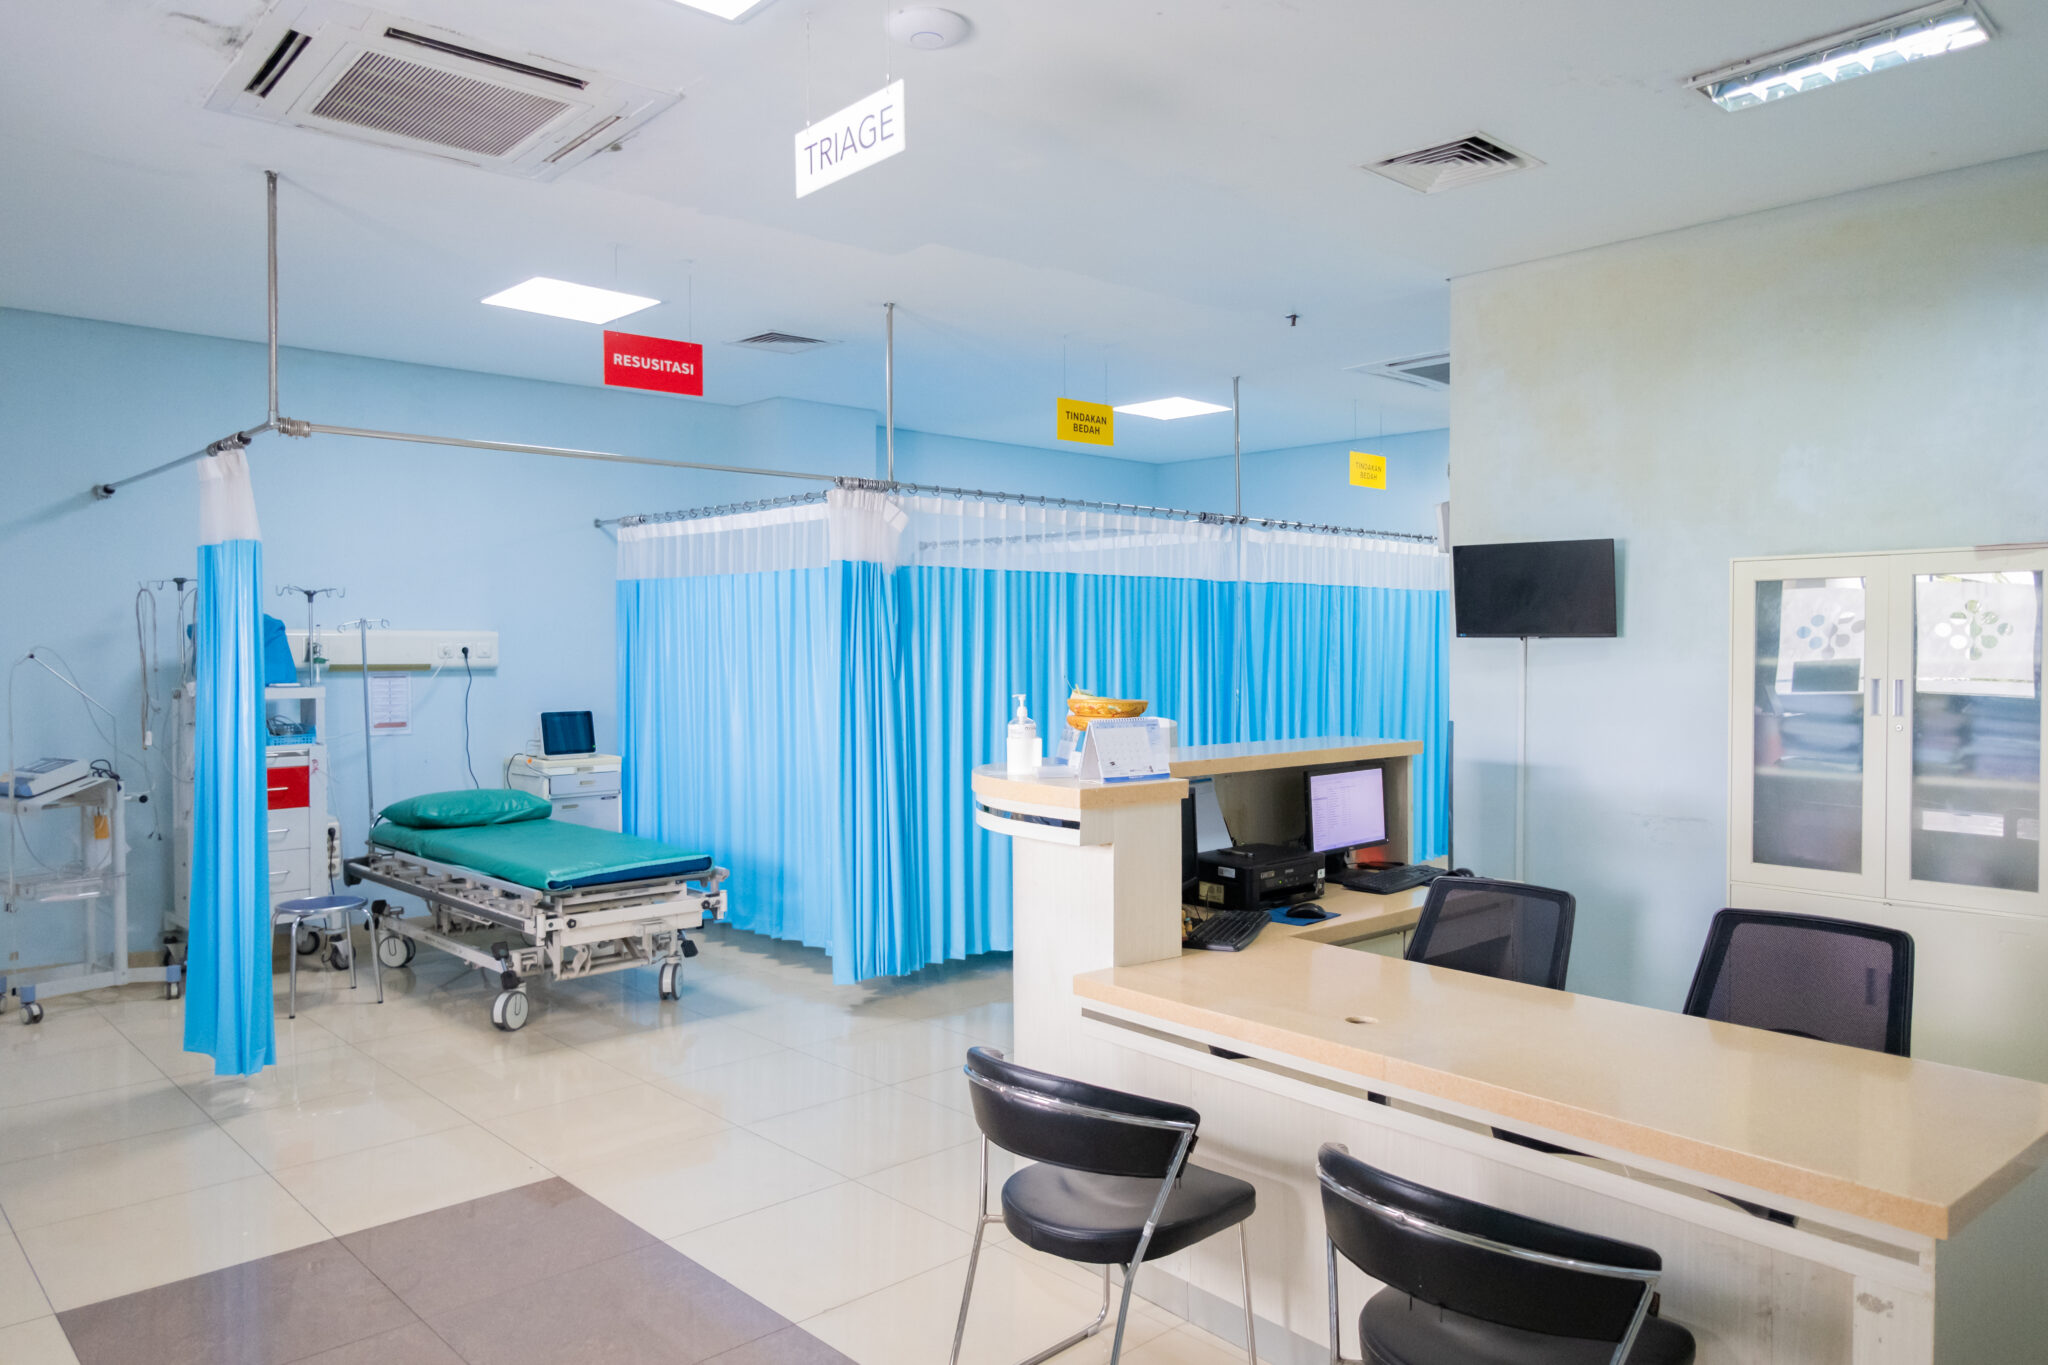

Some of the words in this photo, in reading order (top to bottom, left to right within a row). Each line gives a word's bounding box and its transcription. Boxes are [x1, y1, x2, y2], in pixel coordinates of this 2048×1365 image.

[804, 104, 894, 175] TRIAGE
[613, 353, 694, 375] RESUSITASI
[1065, 410, 1107, 425] TINDAKAN
[1073, 423, 1100, 435] BEDAH
